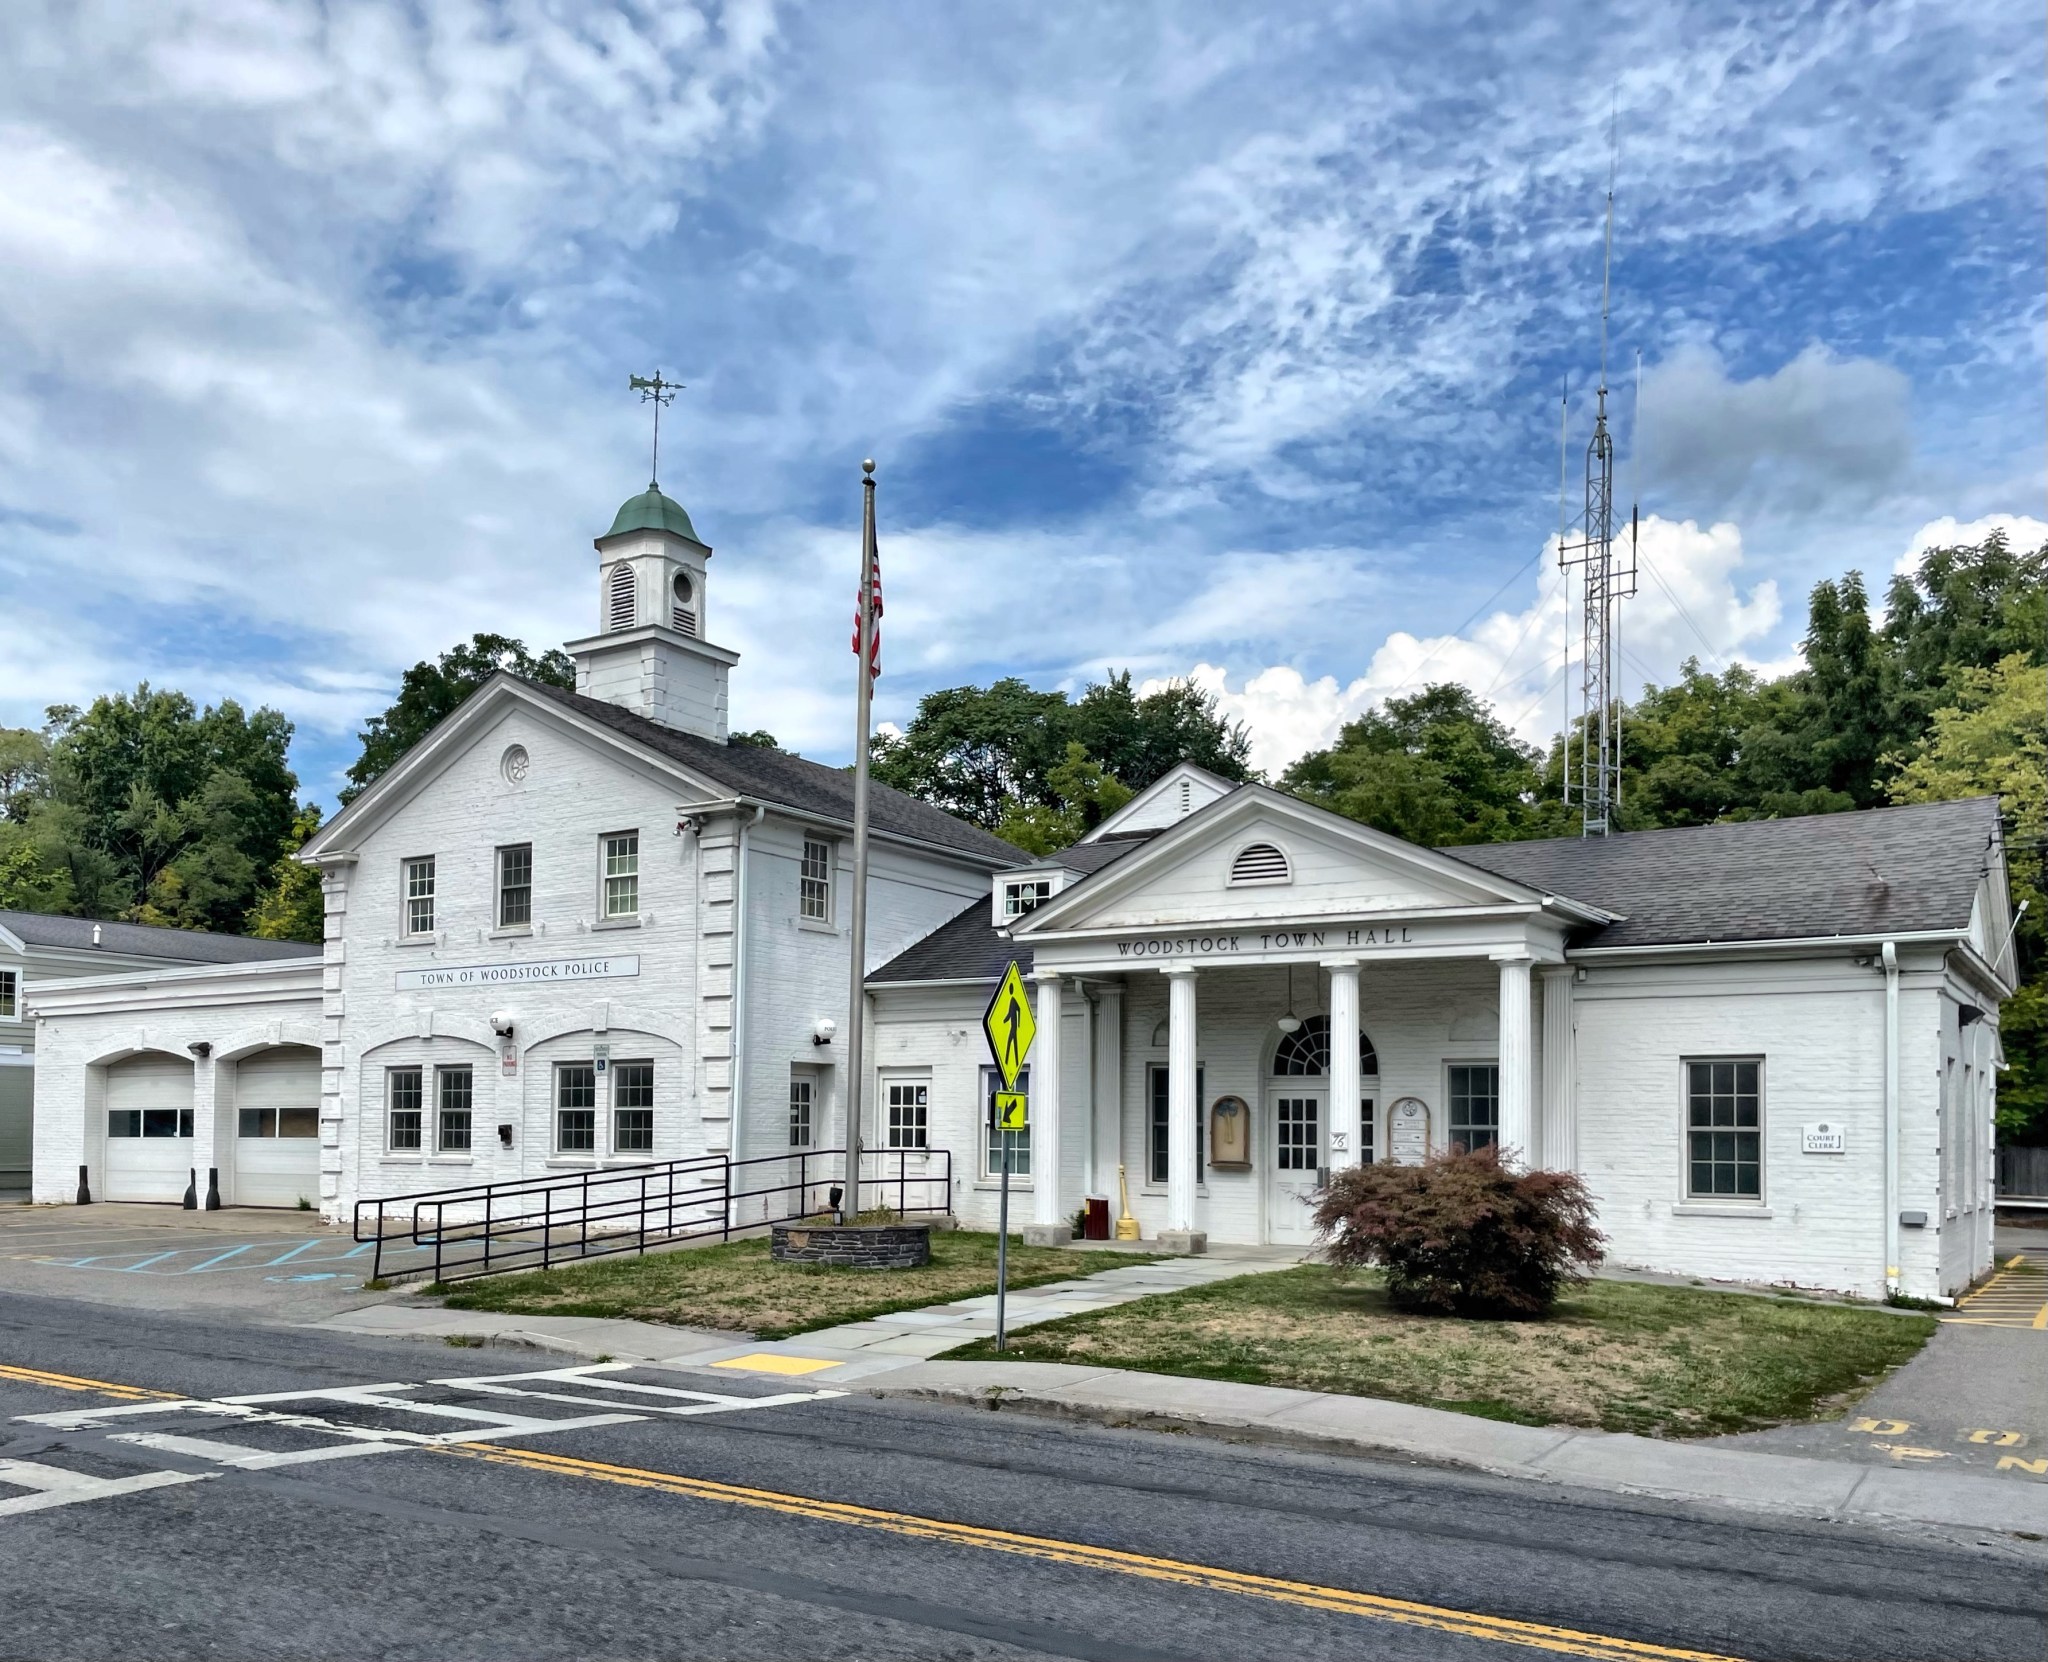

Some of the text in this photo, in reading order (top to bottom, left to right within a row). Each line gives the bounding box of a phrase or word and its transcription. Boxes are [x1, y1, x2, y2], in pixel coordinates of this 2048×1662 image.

[1117, 927, 1413, 956] WOODSTOCK TOWN HALL
[420, 961, 610, 985] TOWN OF WOODSTOCK POLICE
[1331, 1134, 1345, 1148] 76
[1806, 1134, 1835, 1142] COURT
